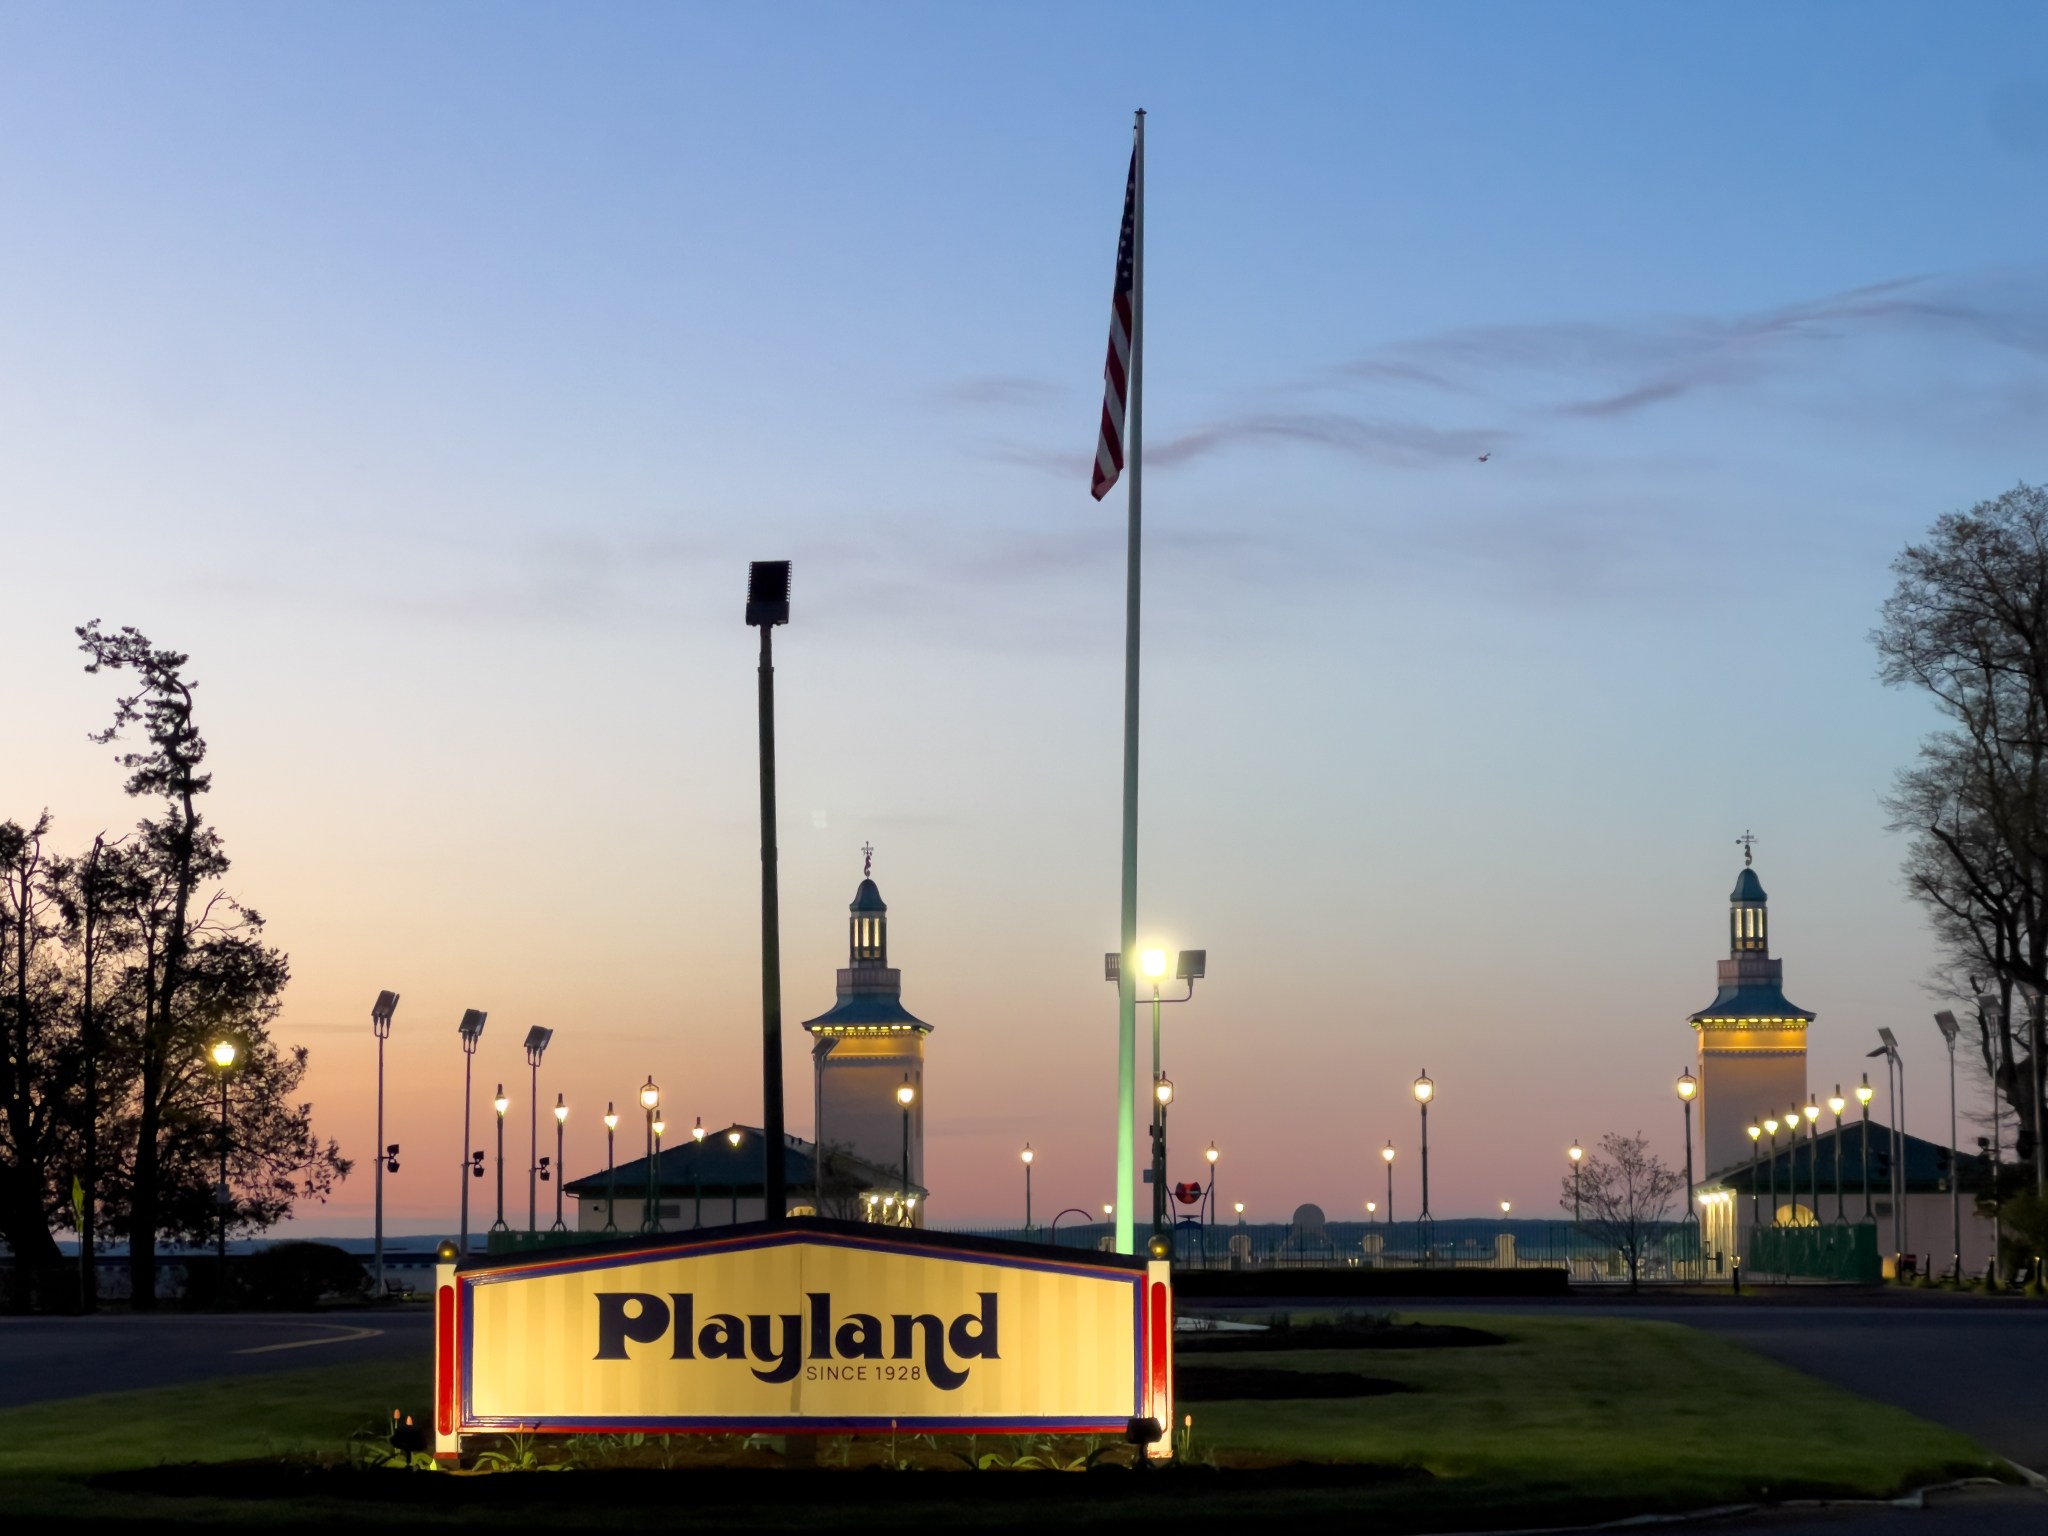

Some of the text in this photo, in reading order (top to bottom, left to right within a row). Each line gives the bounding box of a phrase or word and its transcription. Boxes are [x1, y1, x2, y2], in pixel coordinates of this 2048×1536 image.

[593, 1292, 1001, 1391] Playland
[806, 1366, 921, 1381] SINCE 1928
